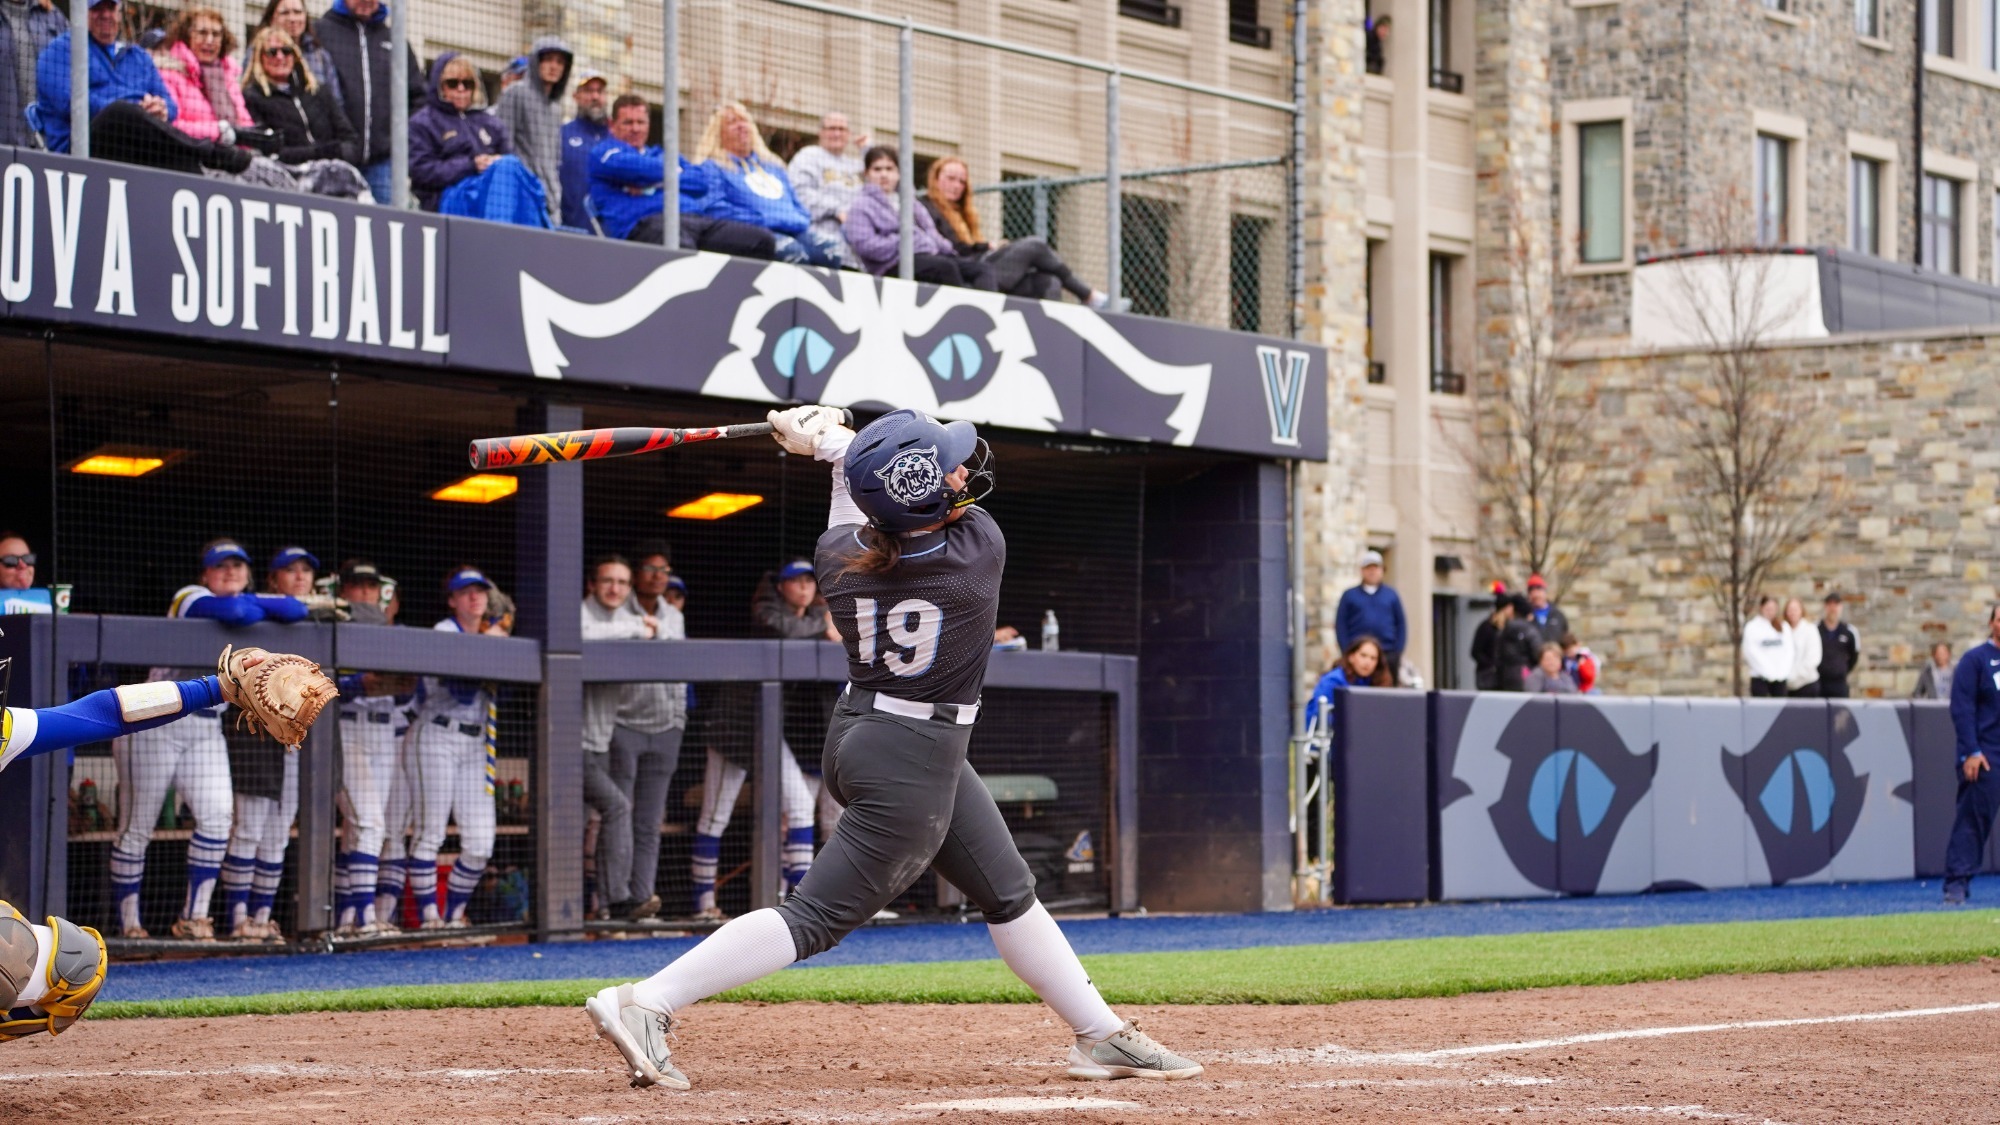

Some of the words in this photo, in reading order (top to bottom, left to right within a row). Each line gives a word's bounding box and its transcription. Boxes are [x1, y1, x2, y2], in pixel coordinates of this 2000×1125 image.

[170, 188, 450, 354] SOFTBALL
[1256, 344, 1311, 446] V
[854, 597, 944, 678] 19
